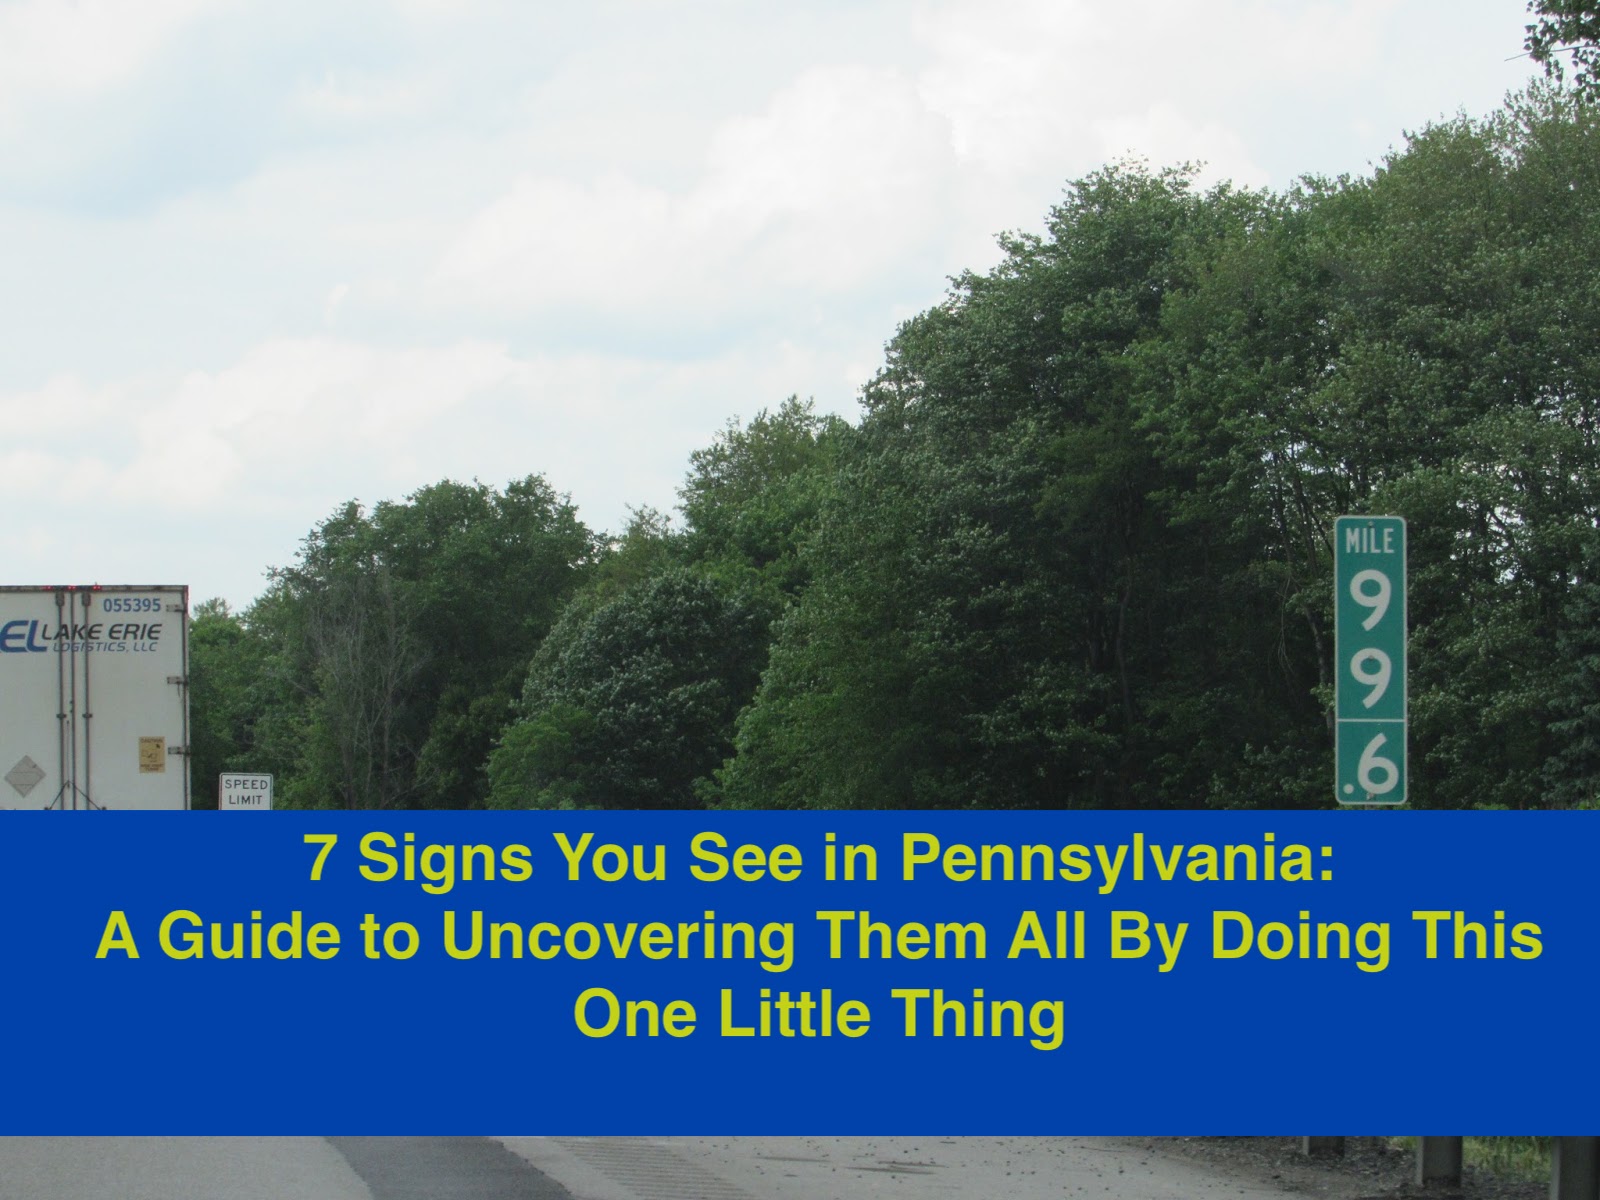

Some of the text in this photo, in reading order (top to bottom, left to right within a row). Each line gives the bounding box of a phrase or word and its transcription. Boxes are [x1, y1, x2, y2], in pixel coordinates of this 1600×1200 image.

[1345, 527, 1394, 553] MILE
[103, 598, 161, 613] 055395
[41, 623, 163, 640] LAKE ERIE
[133, 641, 158, 652] LLC
[225, 779, 268, 790] SPEED
[229, 795, 262, 805] LIMIT
